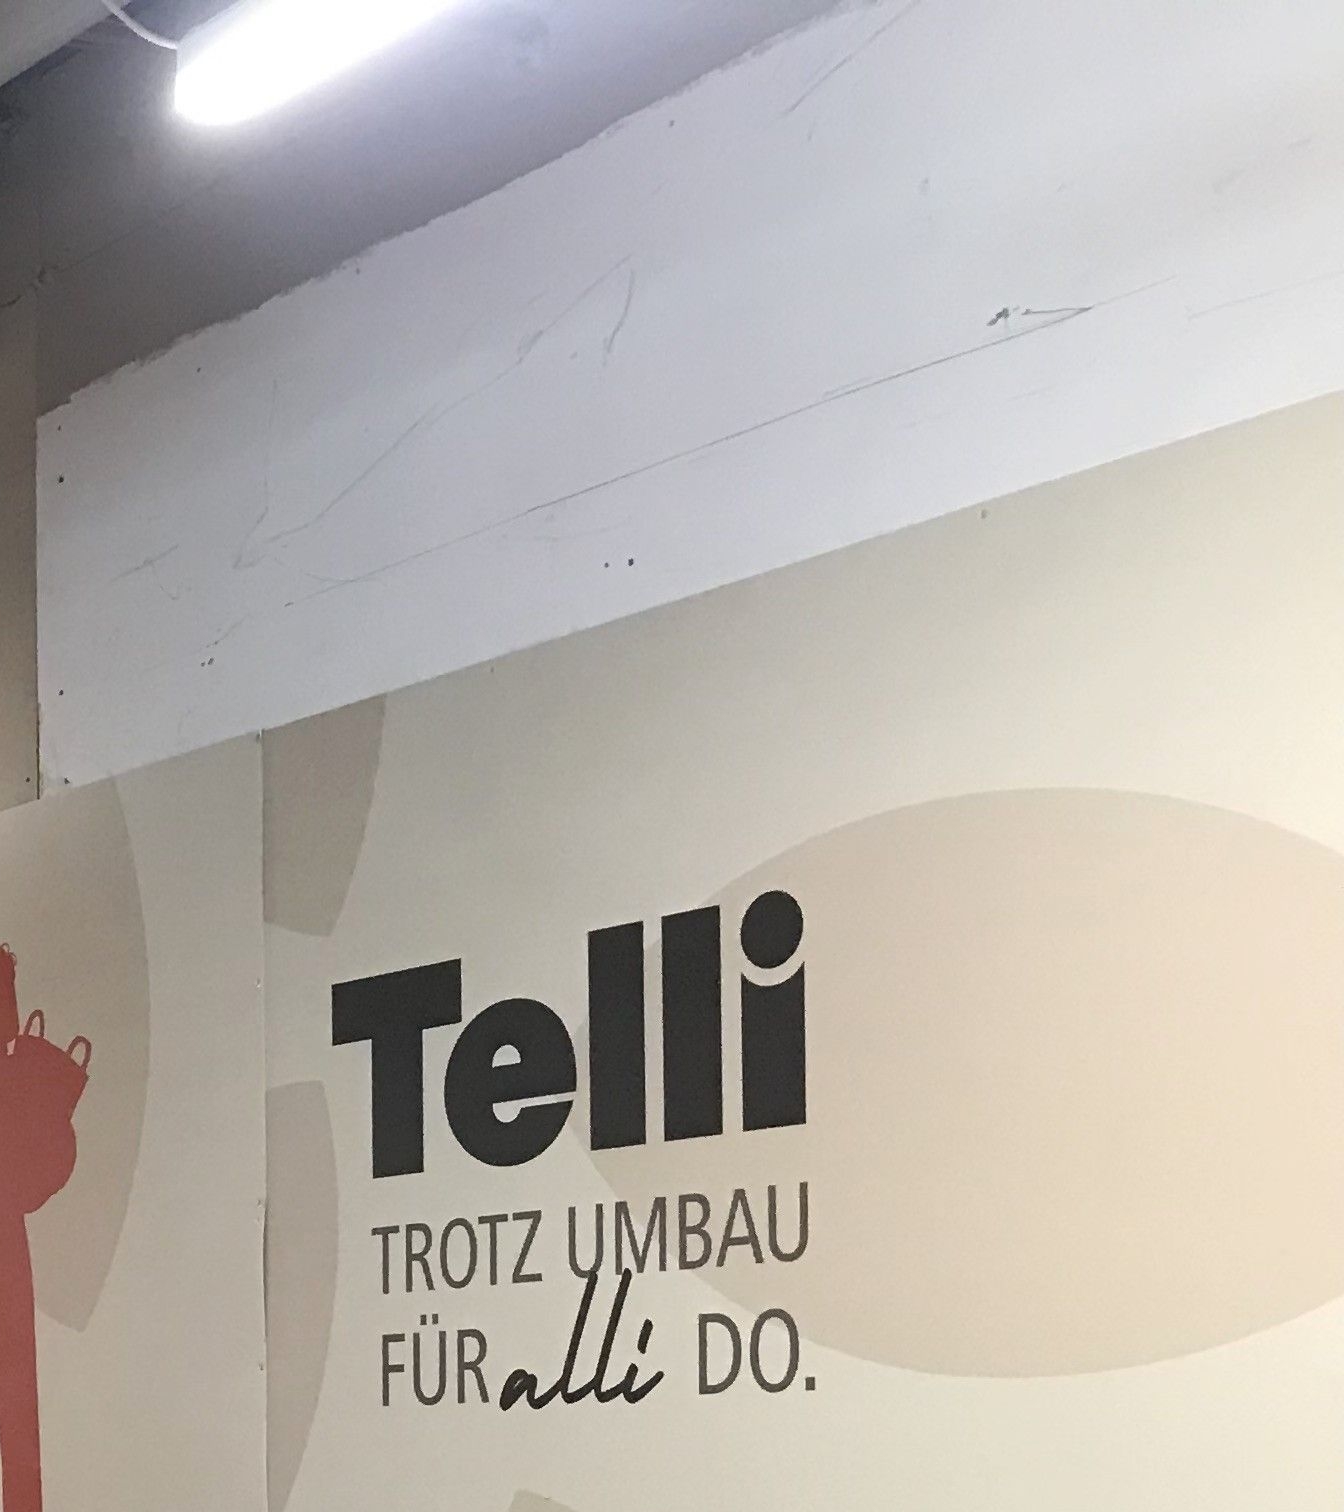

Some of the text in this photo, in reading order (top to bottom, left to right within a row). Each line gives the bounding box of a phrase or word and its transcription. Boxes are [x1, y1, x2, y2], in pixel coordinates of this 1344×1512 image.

[332, 890, 807, 1179] Telli
[371, 1181, 810, 1294] TROTZ UMBAU
[381, 1267, 817, 1411] FÜR alli DO.
